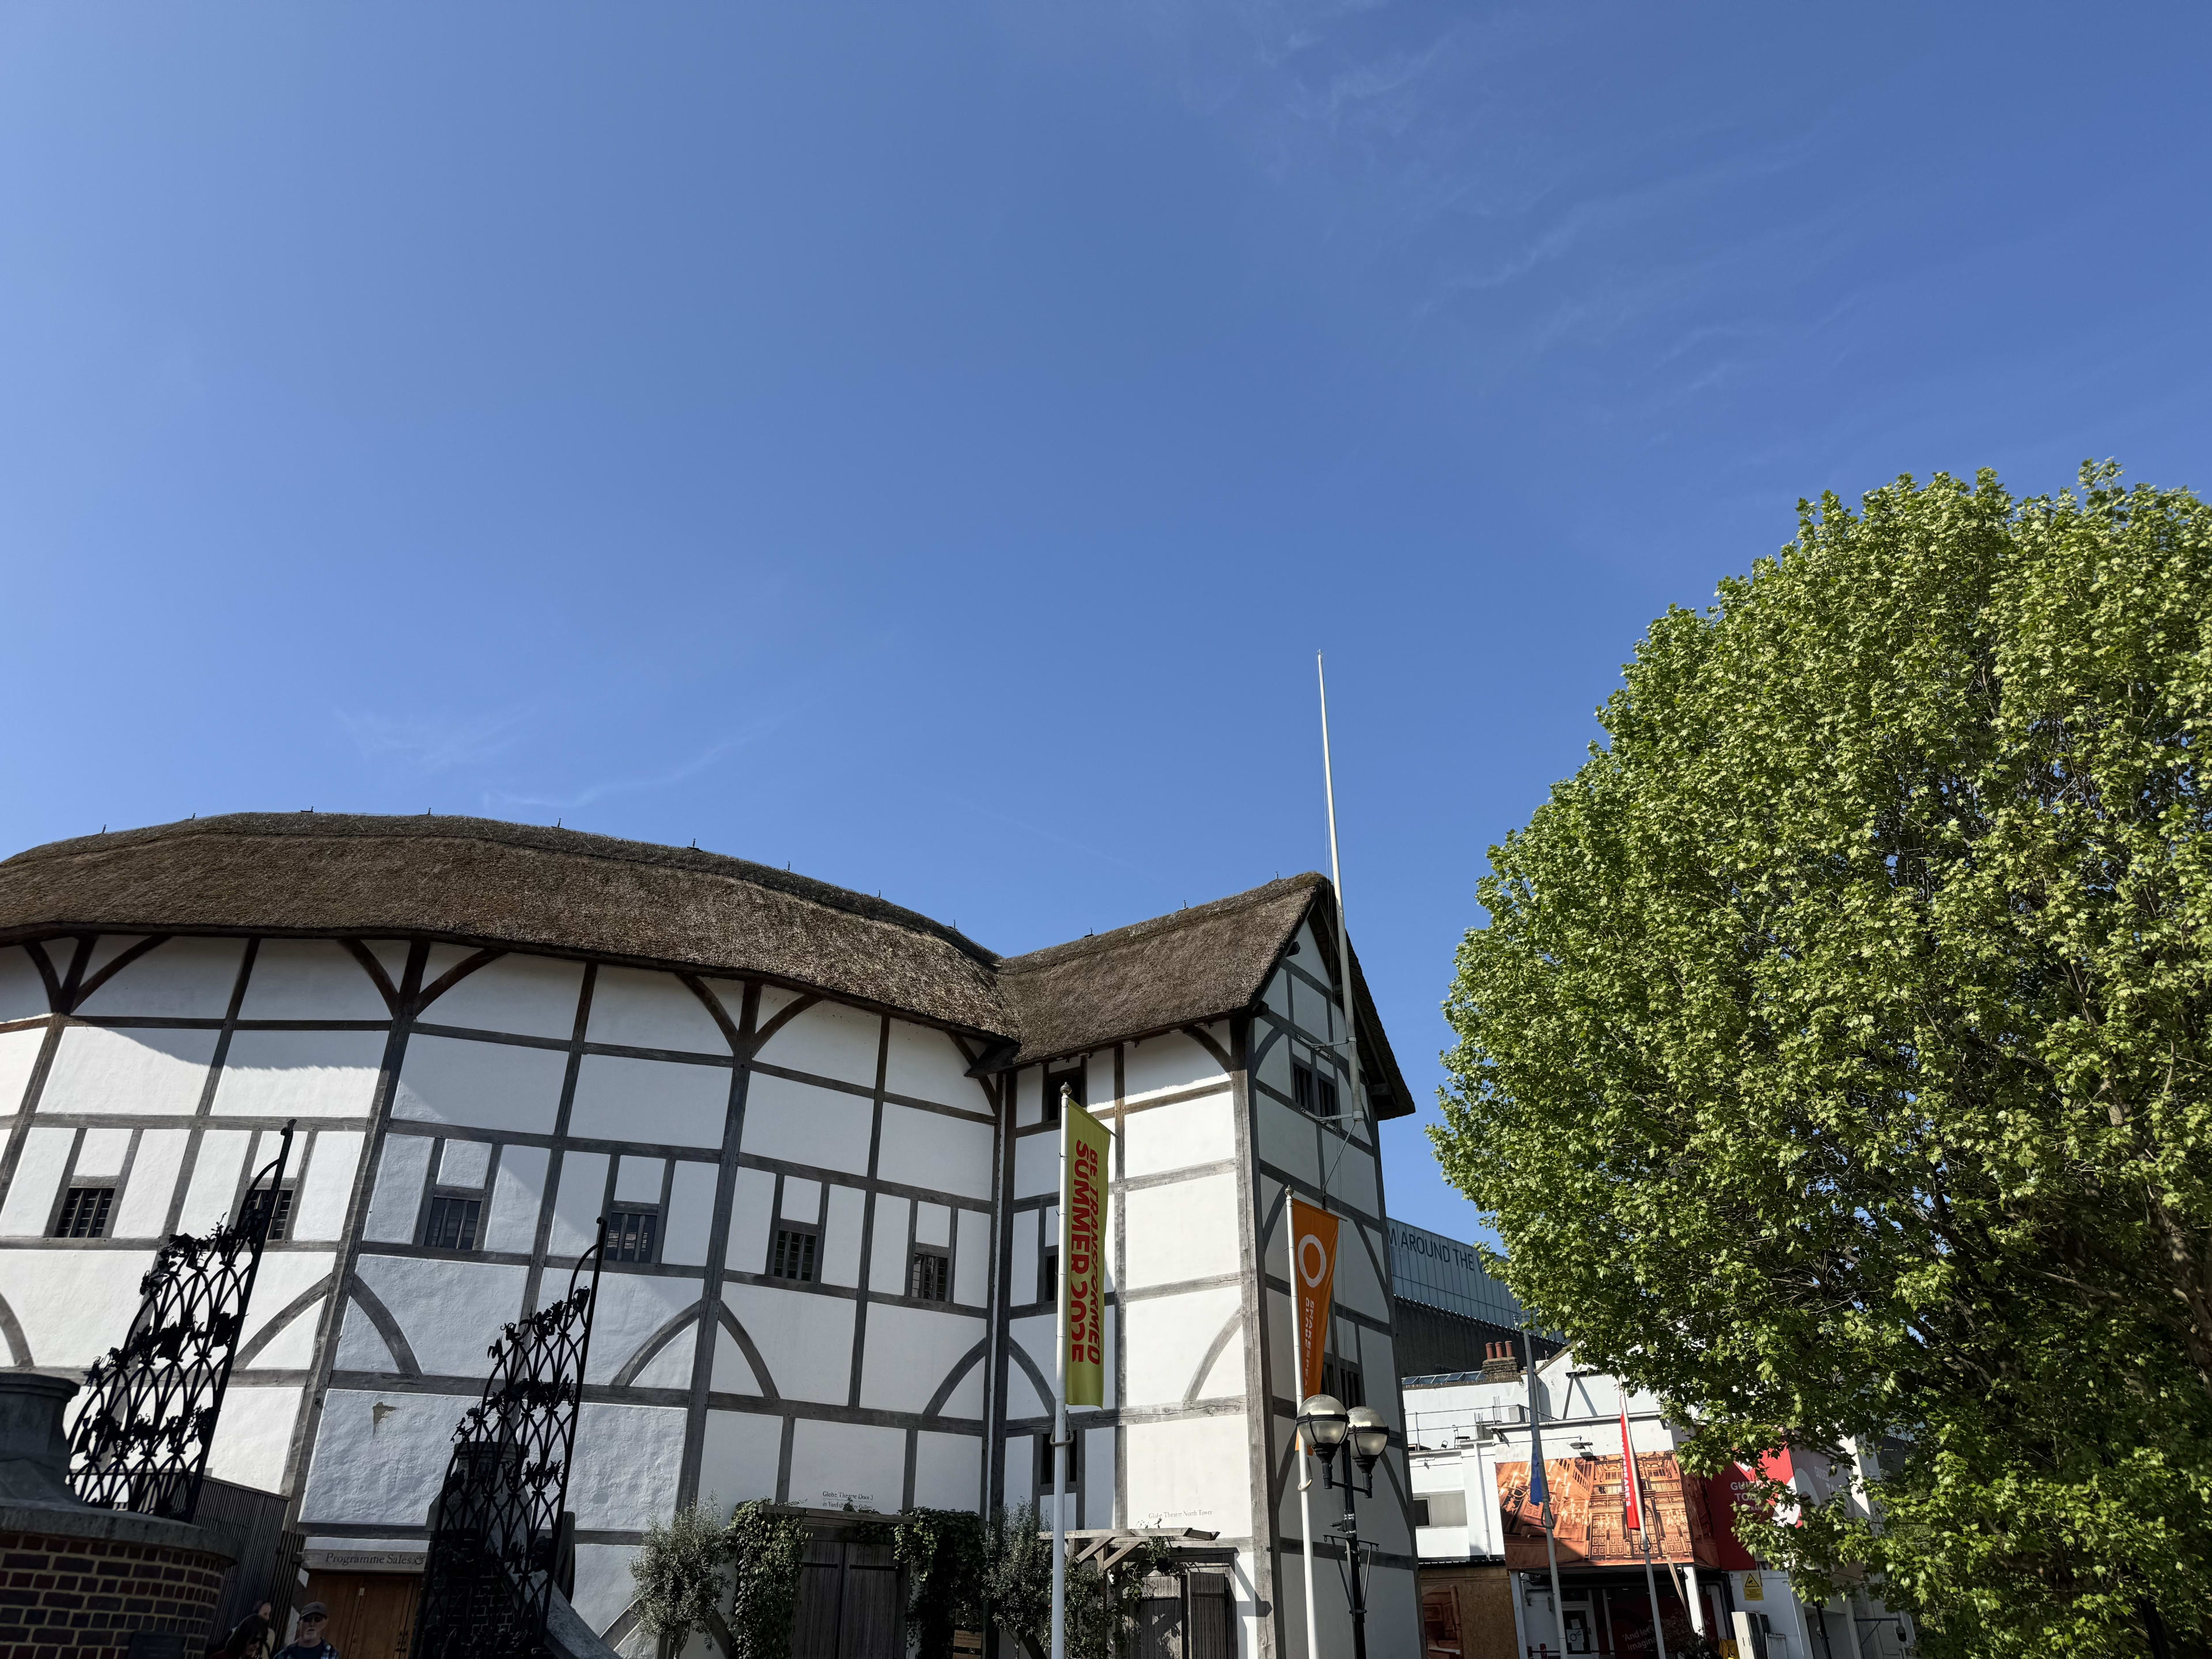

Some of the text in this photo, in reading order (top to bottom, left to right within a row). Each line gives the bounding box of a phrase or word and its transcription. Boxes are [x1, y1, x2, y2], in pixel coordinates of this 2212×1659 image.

[1071, 1139, 1090, 1274] SUMMER
[1087, 1149, 1100, 1365] BE TRANSFORMED
[1401, 1231, 1450, 1263] AROUND
[1452, 1248, 1474, 1271] THE
[325, 1552, 385, 1566] Programme
[387, 1553, 412, 1565] Sales
